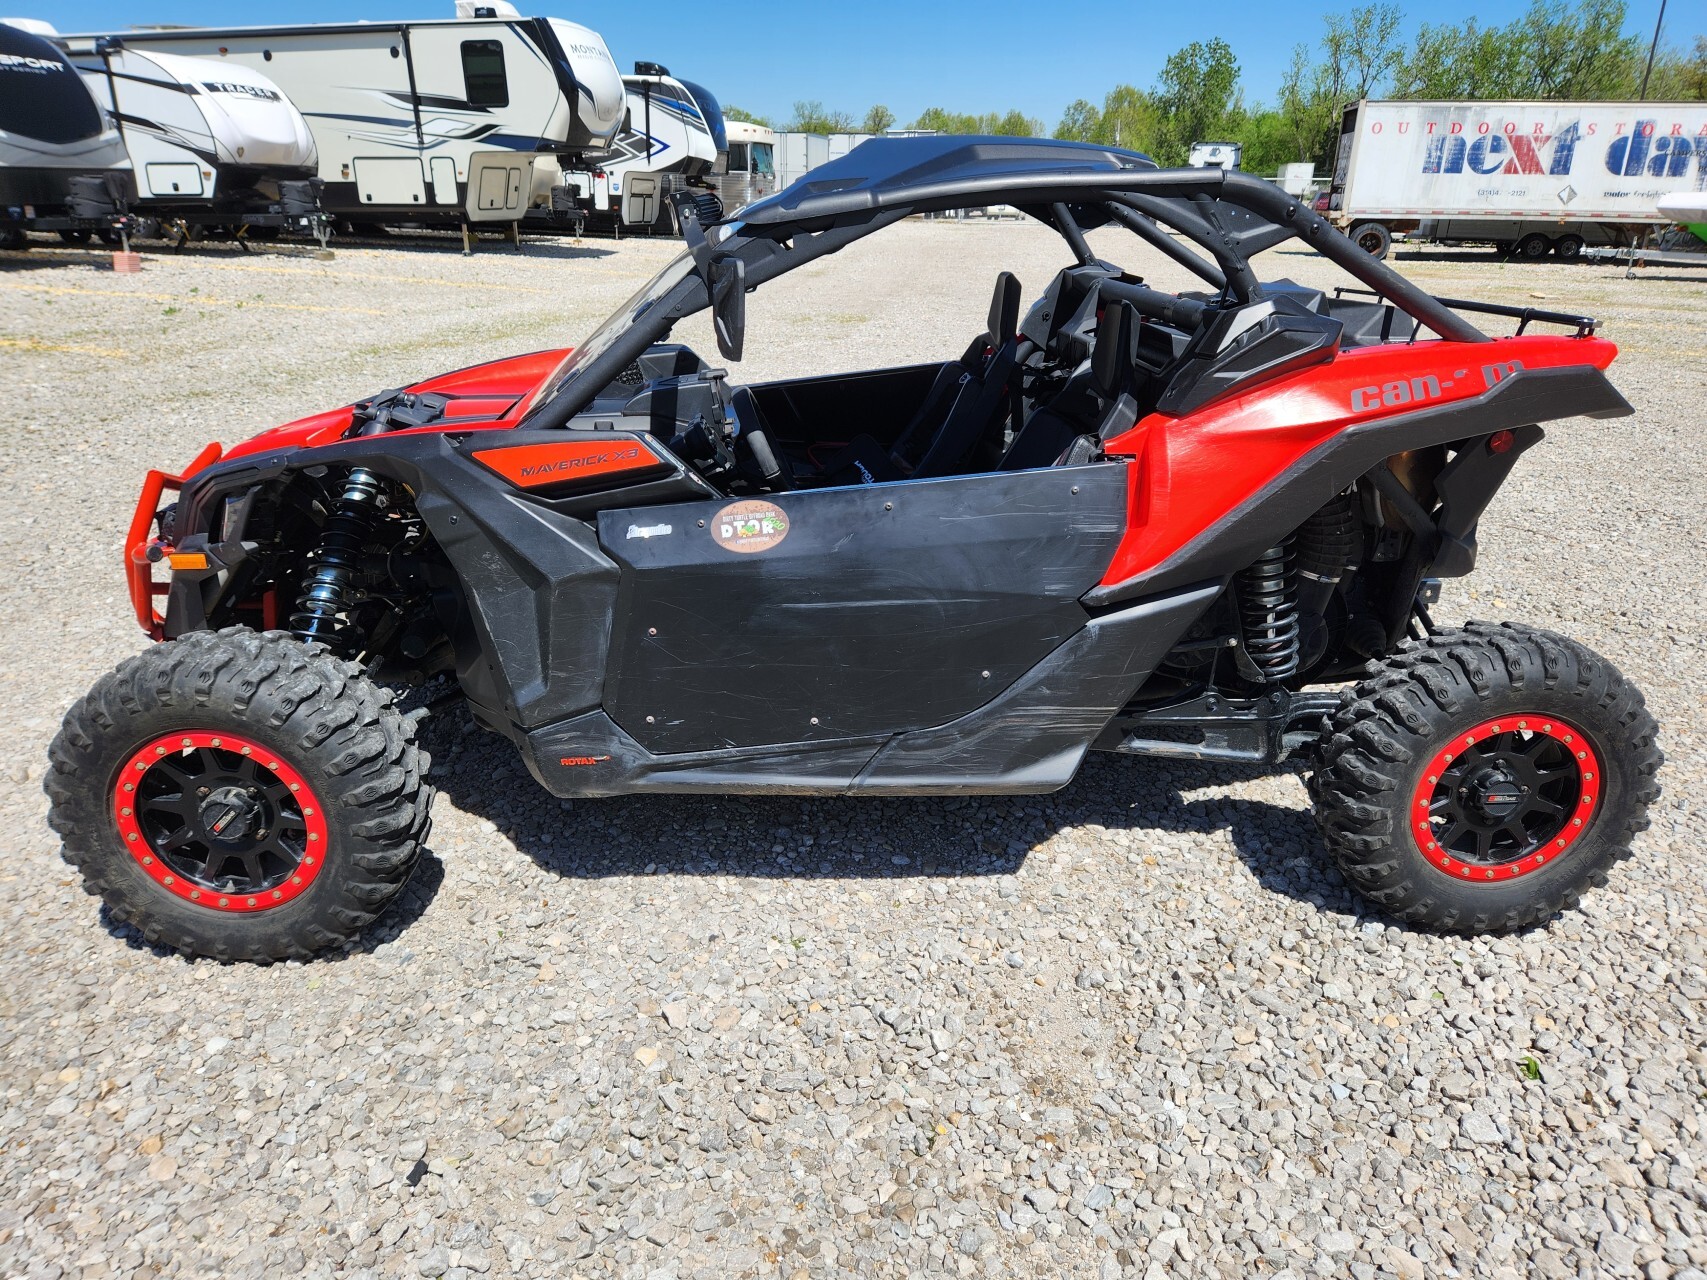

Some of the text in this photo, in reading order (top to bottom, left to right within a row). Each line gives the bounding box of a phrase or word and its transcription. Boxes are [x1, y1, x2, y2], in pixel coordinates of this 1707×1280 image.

[213, 82, 275, 98] TRACER
[1371, 122, 1546, 136] OUTDOOR
[1422, 119, 1584, 175] next
[521, 448, 639, 477] MAVERICK X3
